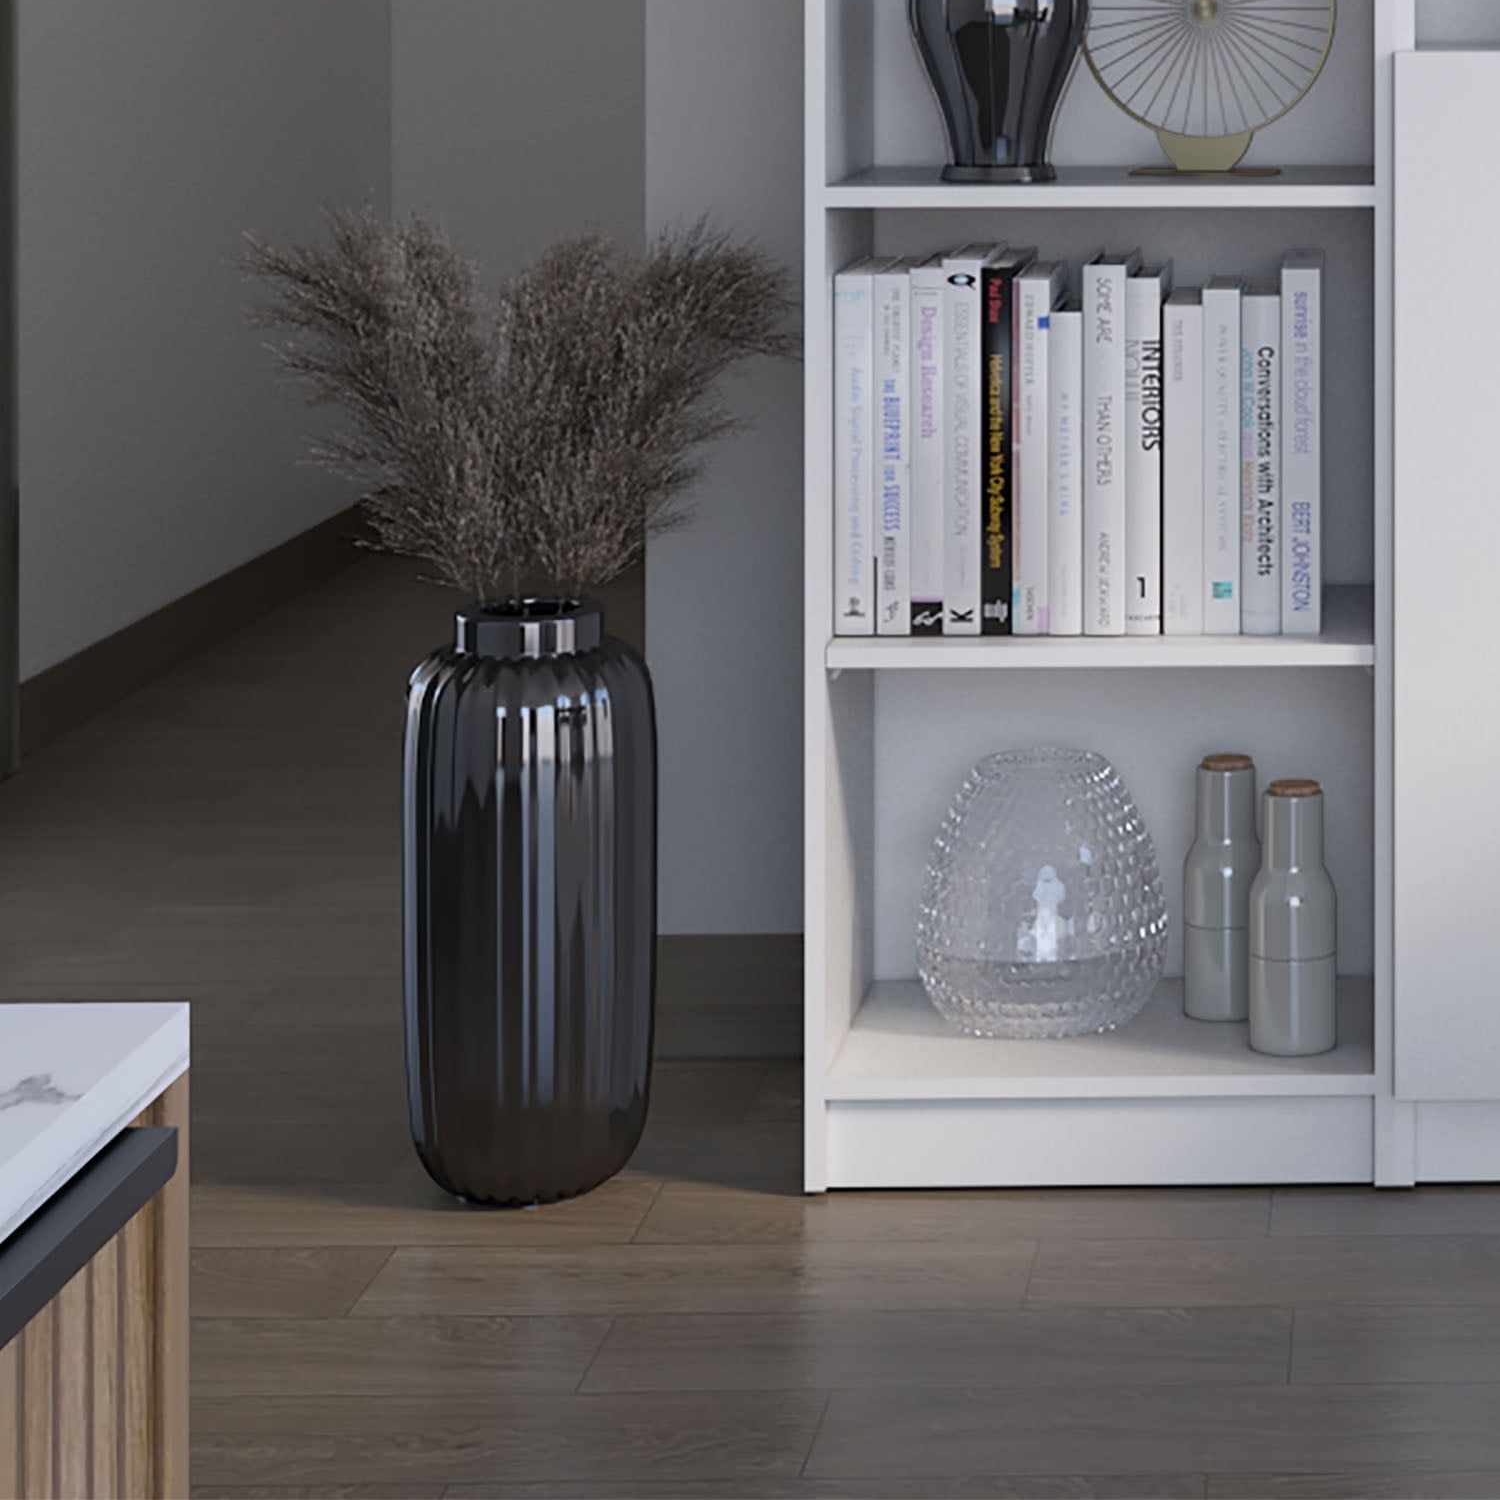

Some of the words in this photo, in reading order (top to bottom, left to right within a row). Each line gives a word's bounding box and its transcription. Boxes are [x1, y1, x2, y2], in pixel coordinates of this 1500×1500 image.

[988, 278, 1002, 298] Paul
[1096, 277, 1112, 314] SOME
[1096, 317, 1112, 344] ARE
[1294, 291, 1311, 339] sunrise
[918, 306, 938, 361] Design
[1294, 343, 1313, 353] in
[1294, 355, 1313, 378] the
[921, 365, 938, 439] Research
[989, 398, 1003, 413] and
[1141, 339, 1161, 451] INTERIORS
[1258, 346, 1275, 457] Conversations
[1294, 380, 1313, 415] cloud
[989, 414, 1003, 430] the
[1096, 395, 1112, 432] THAN
[989, 432, 1003, 451] New
[1294, 418, 1313, 454] forest
[989, 453, 1004, 475] York
[1096, 435, 1112, 486] OTHERS
[1258, 462, 1275, 494] with
[1292, 502, 1311, 533] BERT
[1258, 498, 1275, 576] Architects
[1292, 536, 1311, 612] JOHNSTON
